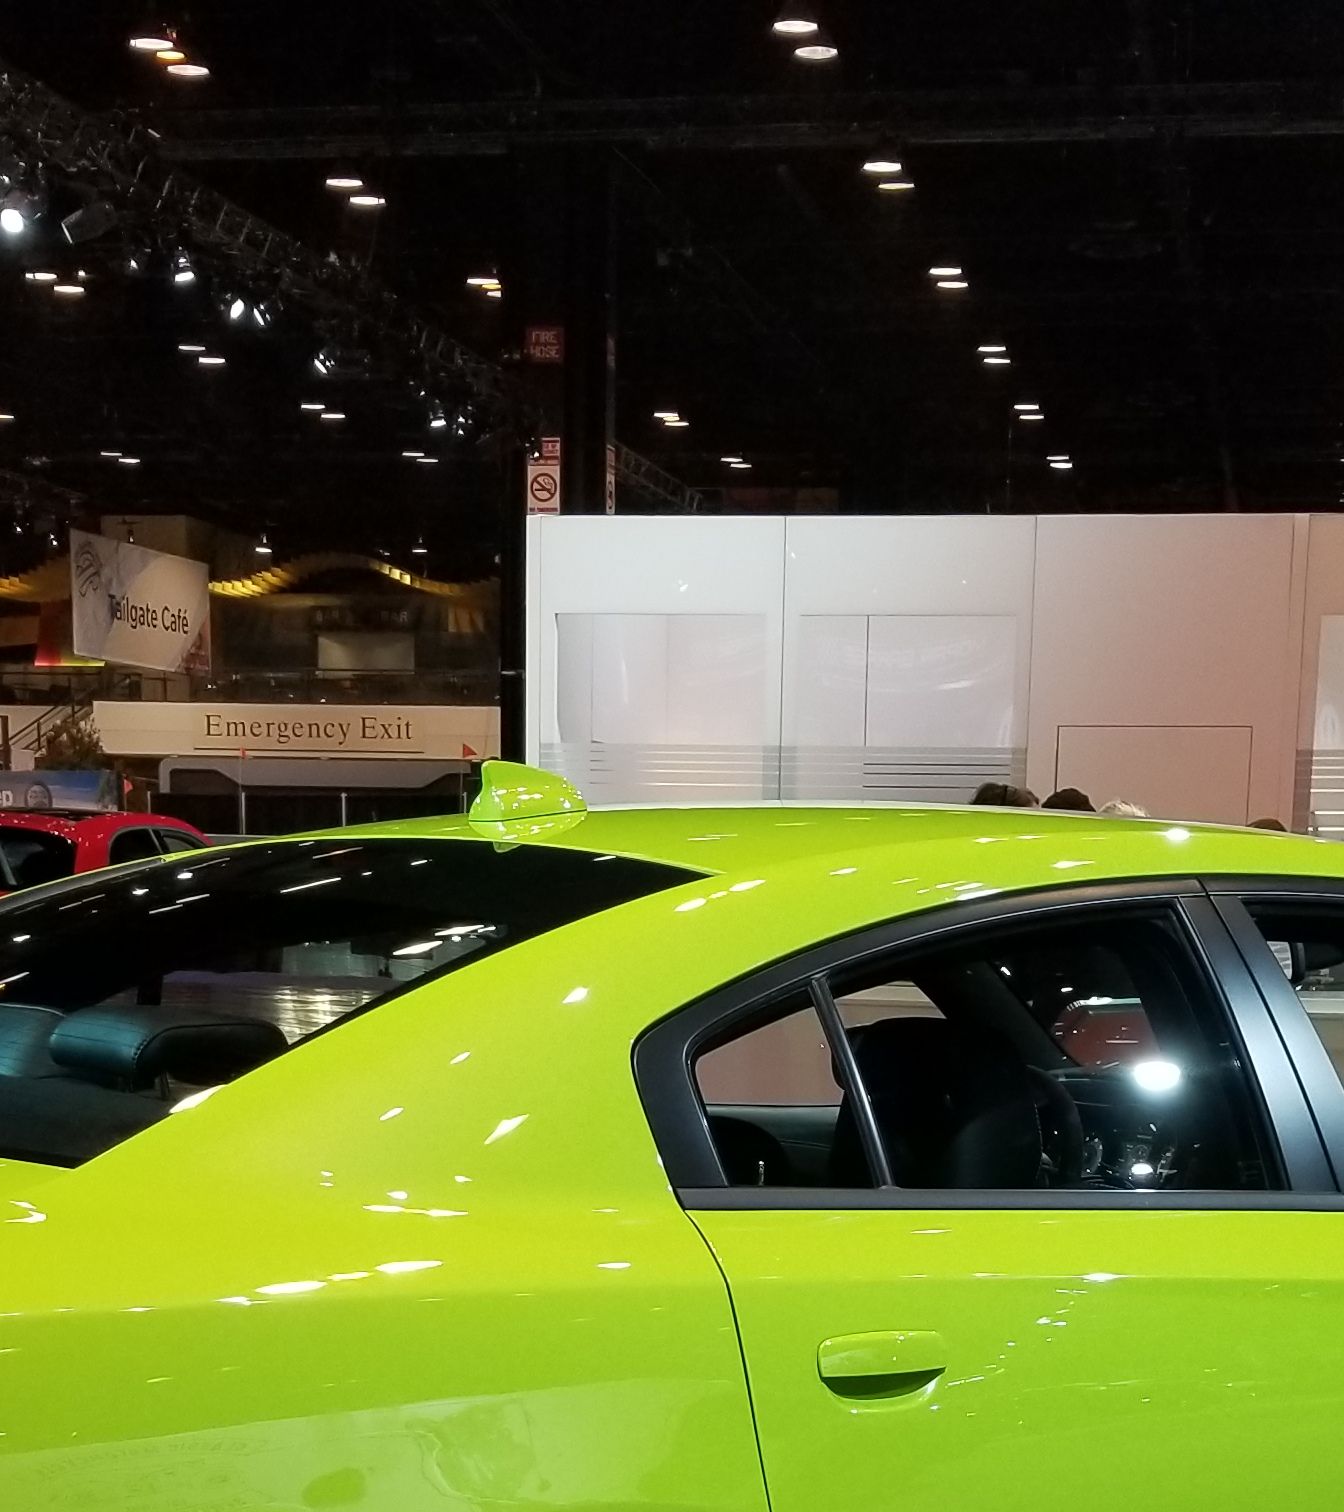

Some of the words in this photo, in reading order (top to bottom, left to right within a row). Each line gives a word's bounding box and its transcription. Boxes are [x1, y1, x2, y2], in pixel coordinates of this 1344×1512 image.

[108, 593, 158, 629] Tailgate
[161, 605, 189, 634] Café
[204, 714, 351, 746] Emergency
[360, 716, 413, 740] Exit
